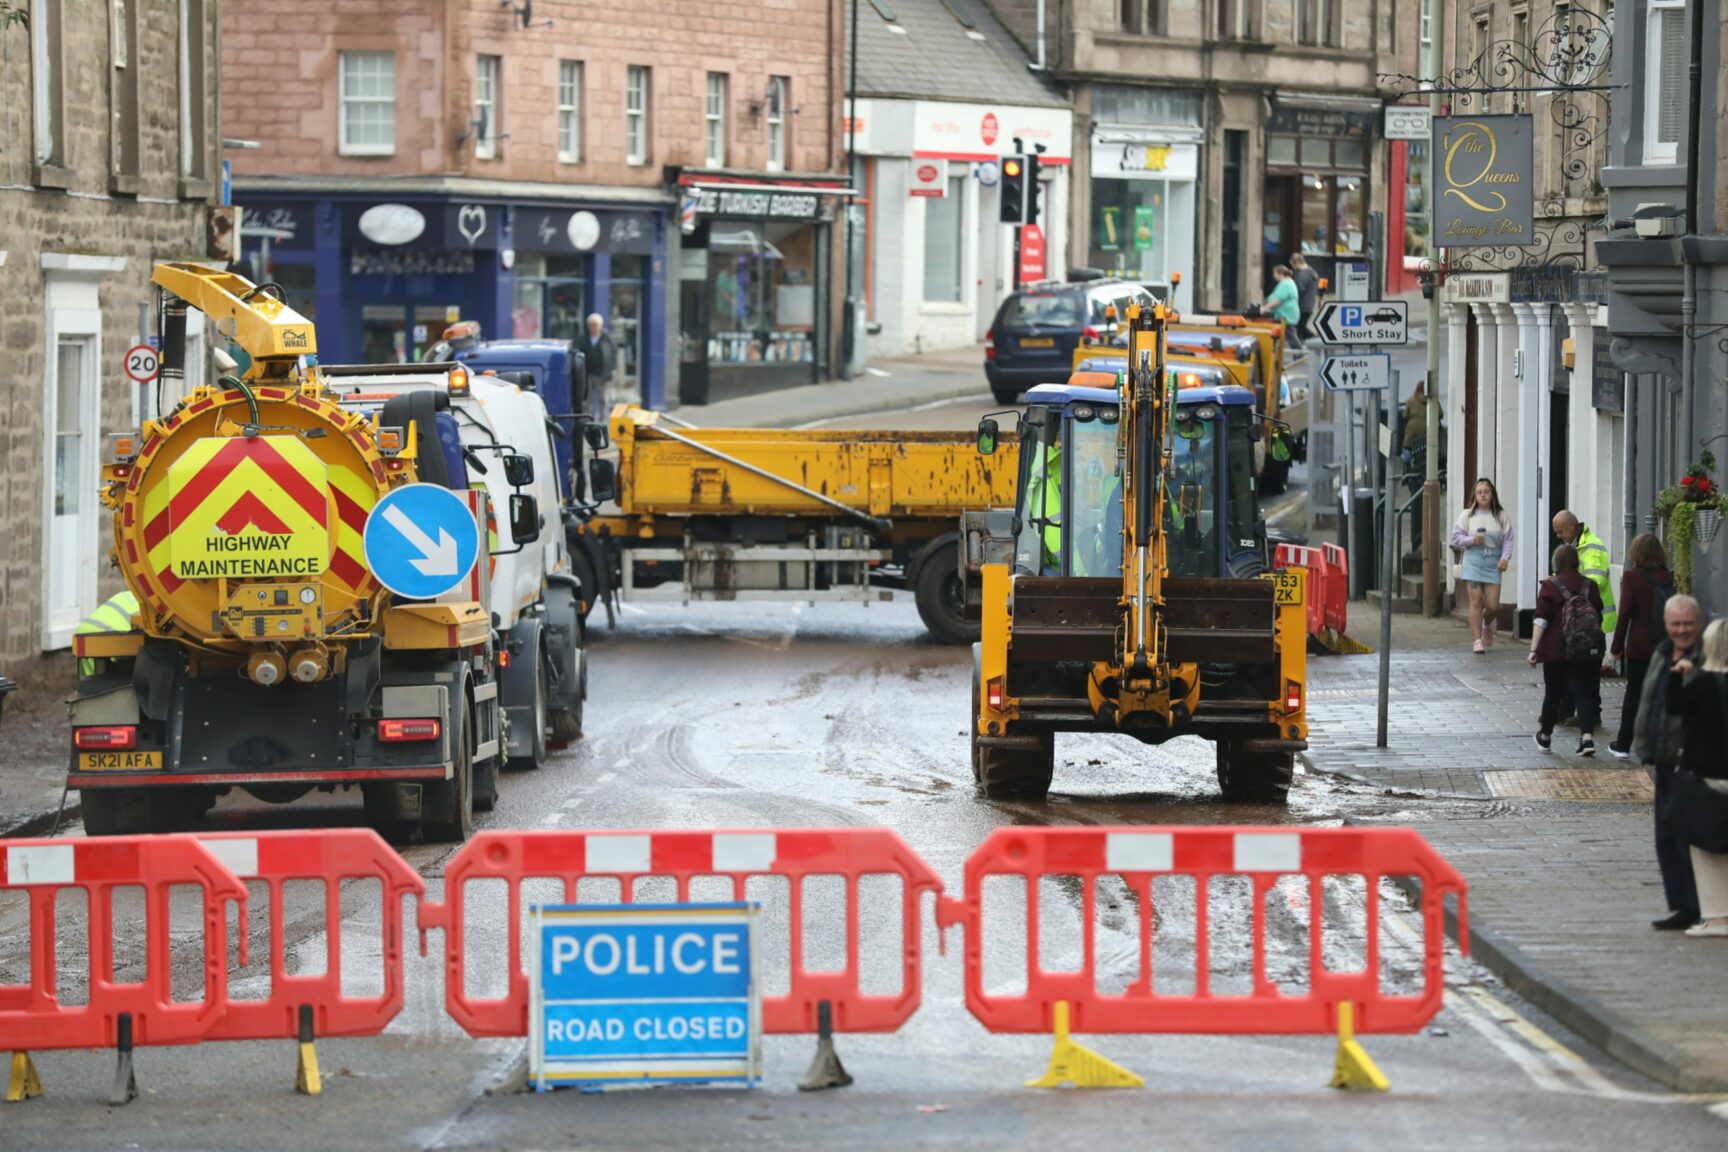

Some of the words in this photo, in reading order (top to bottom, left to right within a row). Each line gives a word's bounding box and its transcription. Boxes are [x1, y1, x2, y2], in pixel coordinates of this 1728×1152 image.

[1443, 121, 1521, 213] Queens
[719, 192, 770, 215] TURKISH
[1446, 218, 1489, 240] Lounge
[1491, 218, 1524, 234] Bar
[1346, 308, 1359, 325] P
[1341, 329, 1373, 339] Short
[1377, 329, 1402, 340] Stay
[284, 340, 308, 348] WHALE
[130, 356, 156, 372] 20
[1340, 360, 1369, 368] Toilets
[206, 535, 292, 552] HIGHWAY
[180, 557, 319, 576] MAINTENANCE
[88, 754, 121, 768] SK21
[125, 754, 153, 767] AFA
[551, 932, 741, 975] POLICE
[547, 1018, 625, 1042] ROAD
[633, 1016, 746, 1041] CLOSED
